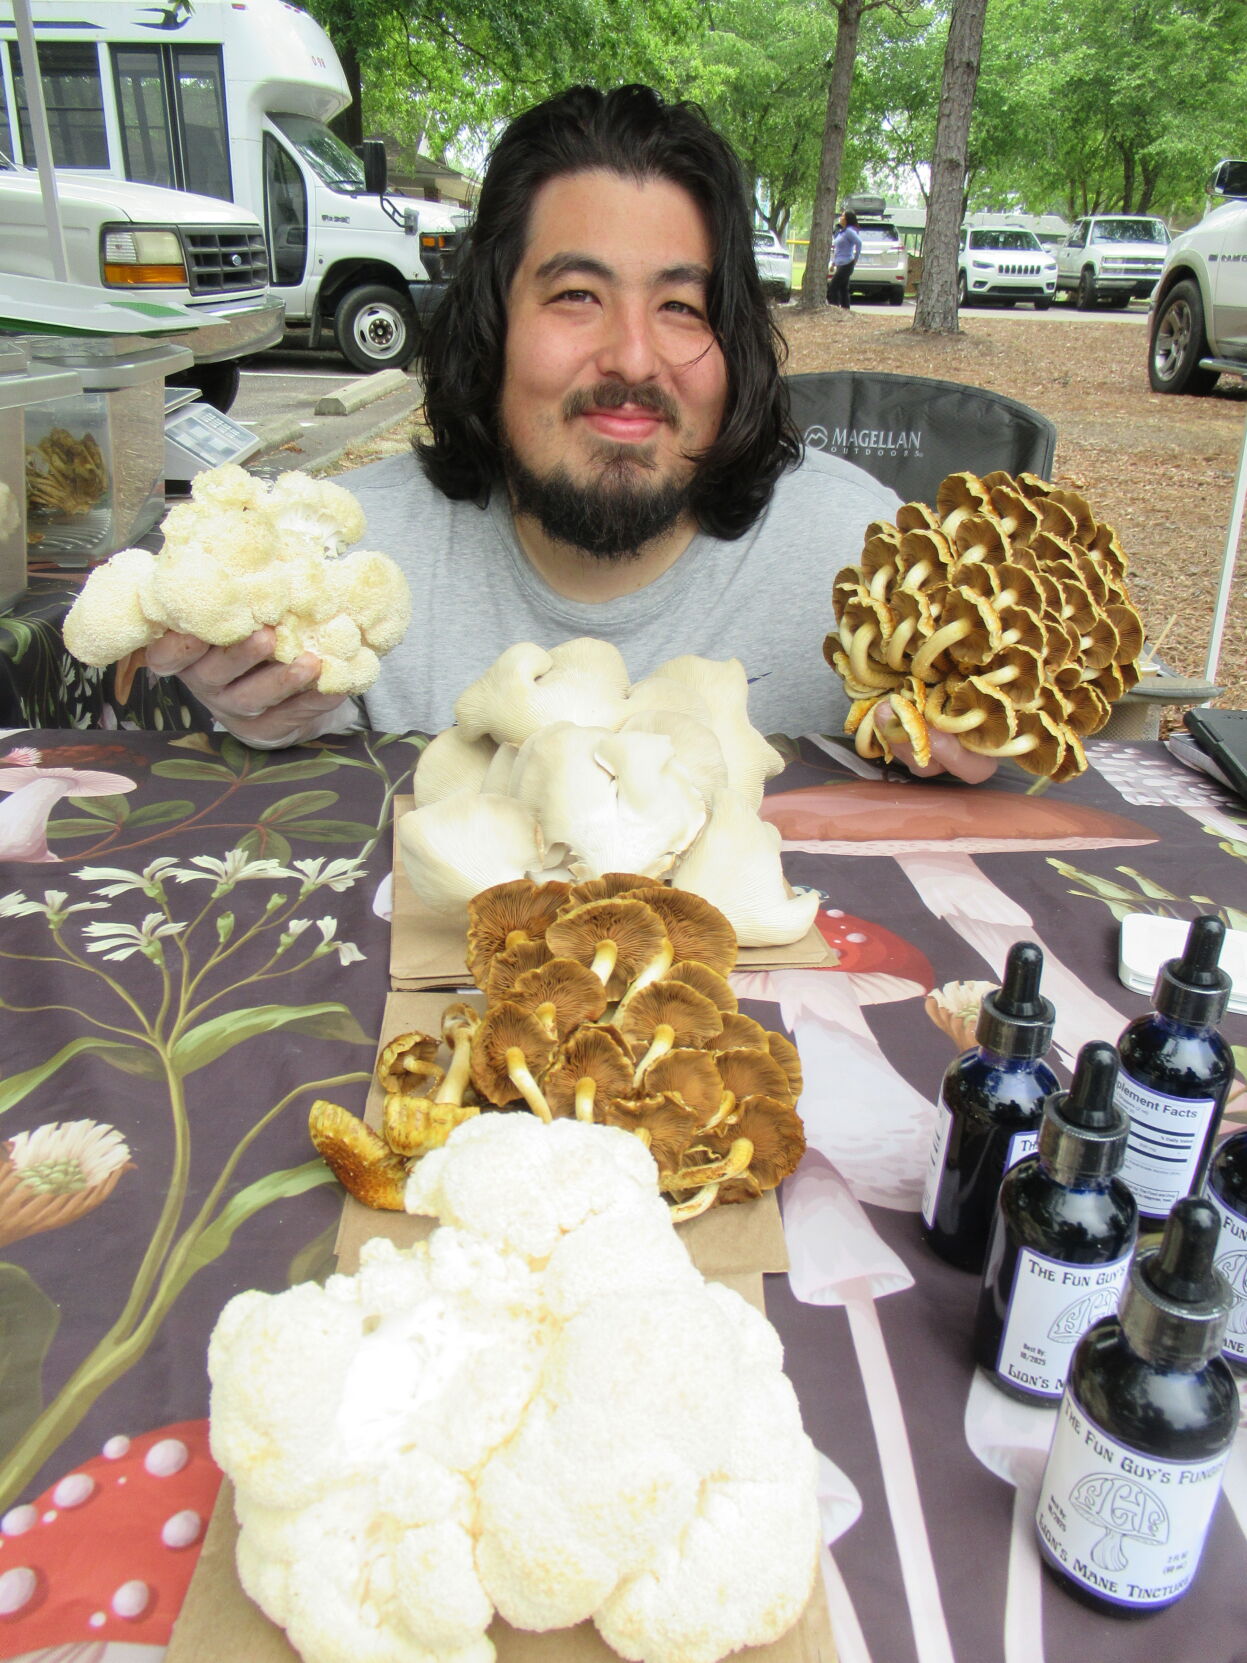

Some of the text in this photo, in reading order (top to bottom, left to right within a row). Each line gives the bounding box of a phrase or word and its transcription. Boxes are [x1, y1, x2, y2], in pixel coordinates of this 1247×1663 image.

[832, 428, 921, 449] MAGELLAN
[1162, 1104, 1198, 1118] Facts
[1028, 1259, 1056, 1282] THE
[1062, 1271, 1091, 1287] FUN
[1008, 1363, 1049, 1389] LION'S
[1065, 1397, 1081, 1434] THE
[1084, 1430, 1114, 1463] FUN
[1120, 1456, 1171, 1485] GUY'S
[1038, 1514, 1068, 1562] LION'S
[1072, 1558, 1118, 1593] MANE
